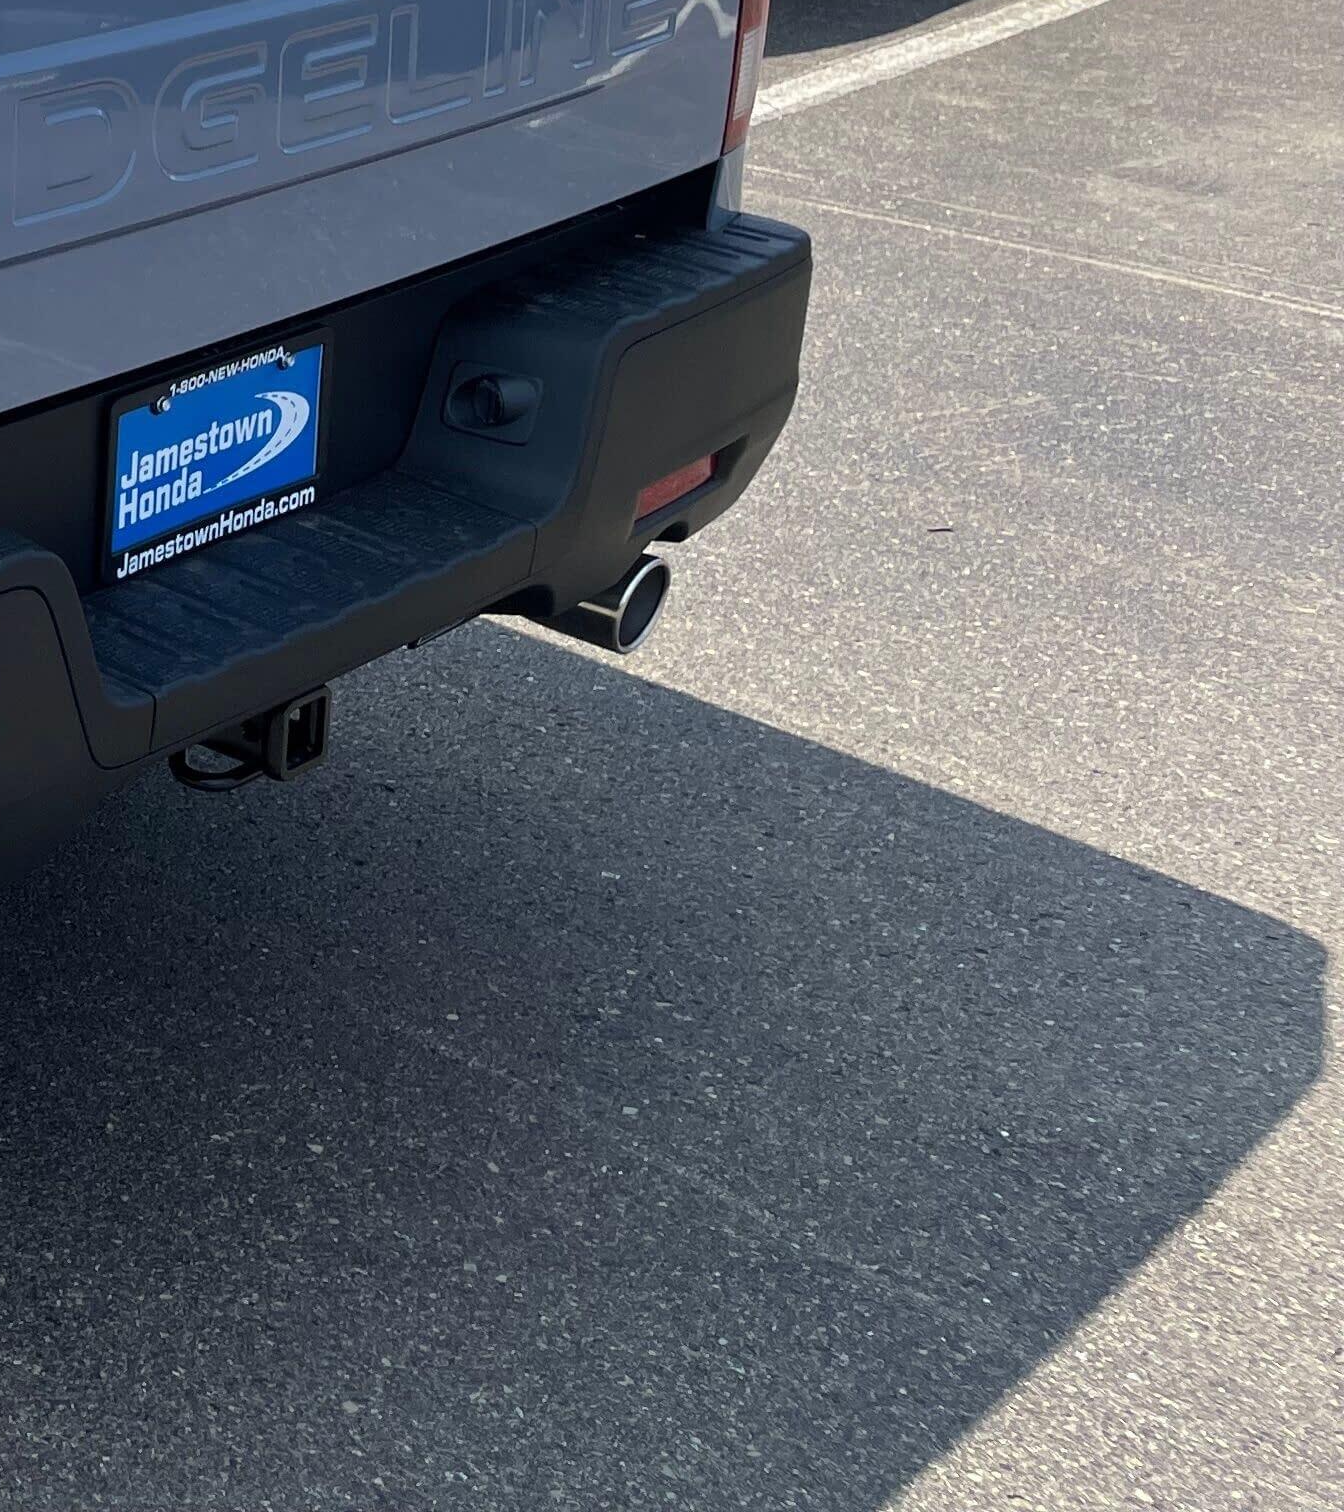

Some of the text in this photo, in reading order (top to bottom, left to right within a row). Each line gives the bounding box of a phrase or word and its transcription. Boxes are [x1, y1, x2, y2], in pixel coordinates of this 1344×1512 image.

[169, 345, 285, 398] 1-800-NEW-HONDA
[120, 407, 273, 489] Jamestown
[116, 485, 316, 580] JamestownHonda.com
[118, 467, 203, 529] Honda
